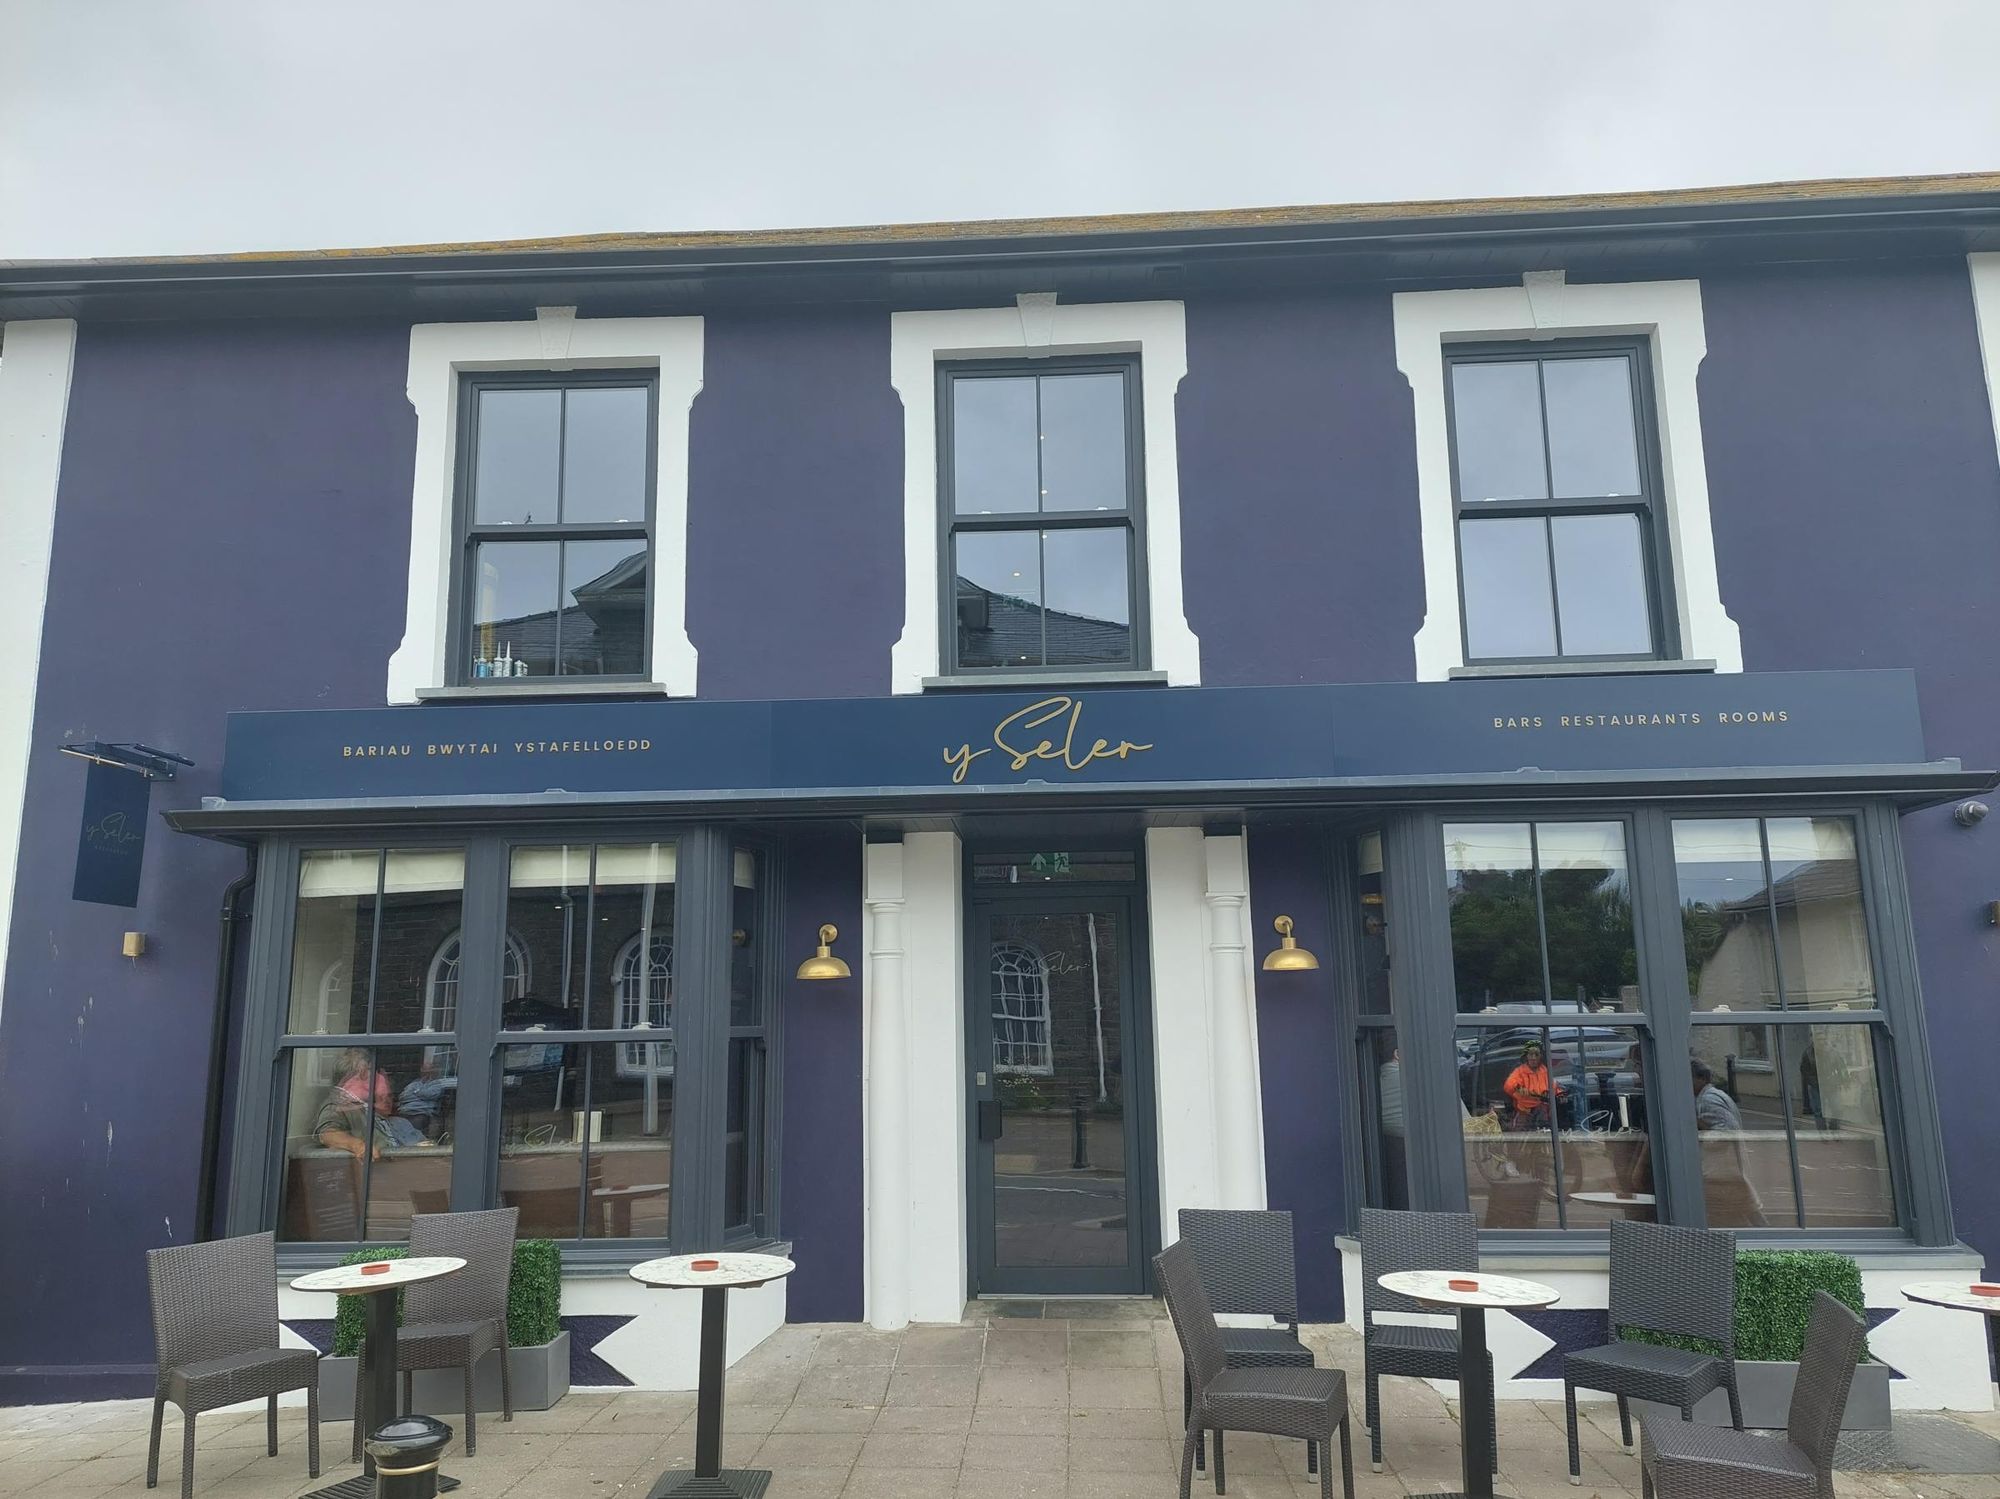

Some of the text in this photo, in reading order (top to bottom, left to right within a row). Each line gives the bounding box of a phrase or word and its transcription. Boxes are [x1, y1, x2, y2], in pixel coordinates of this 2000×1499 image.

[1494, 710, 1789, 729] BARS RESTAURANTS ROOMS
[343, 739, 652, 757] BARIAU BWYTAI YSTAFELLOEDD
[943, 695, 1154, 784] y Seler
